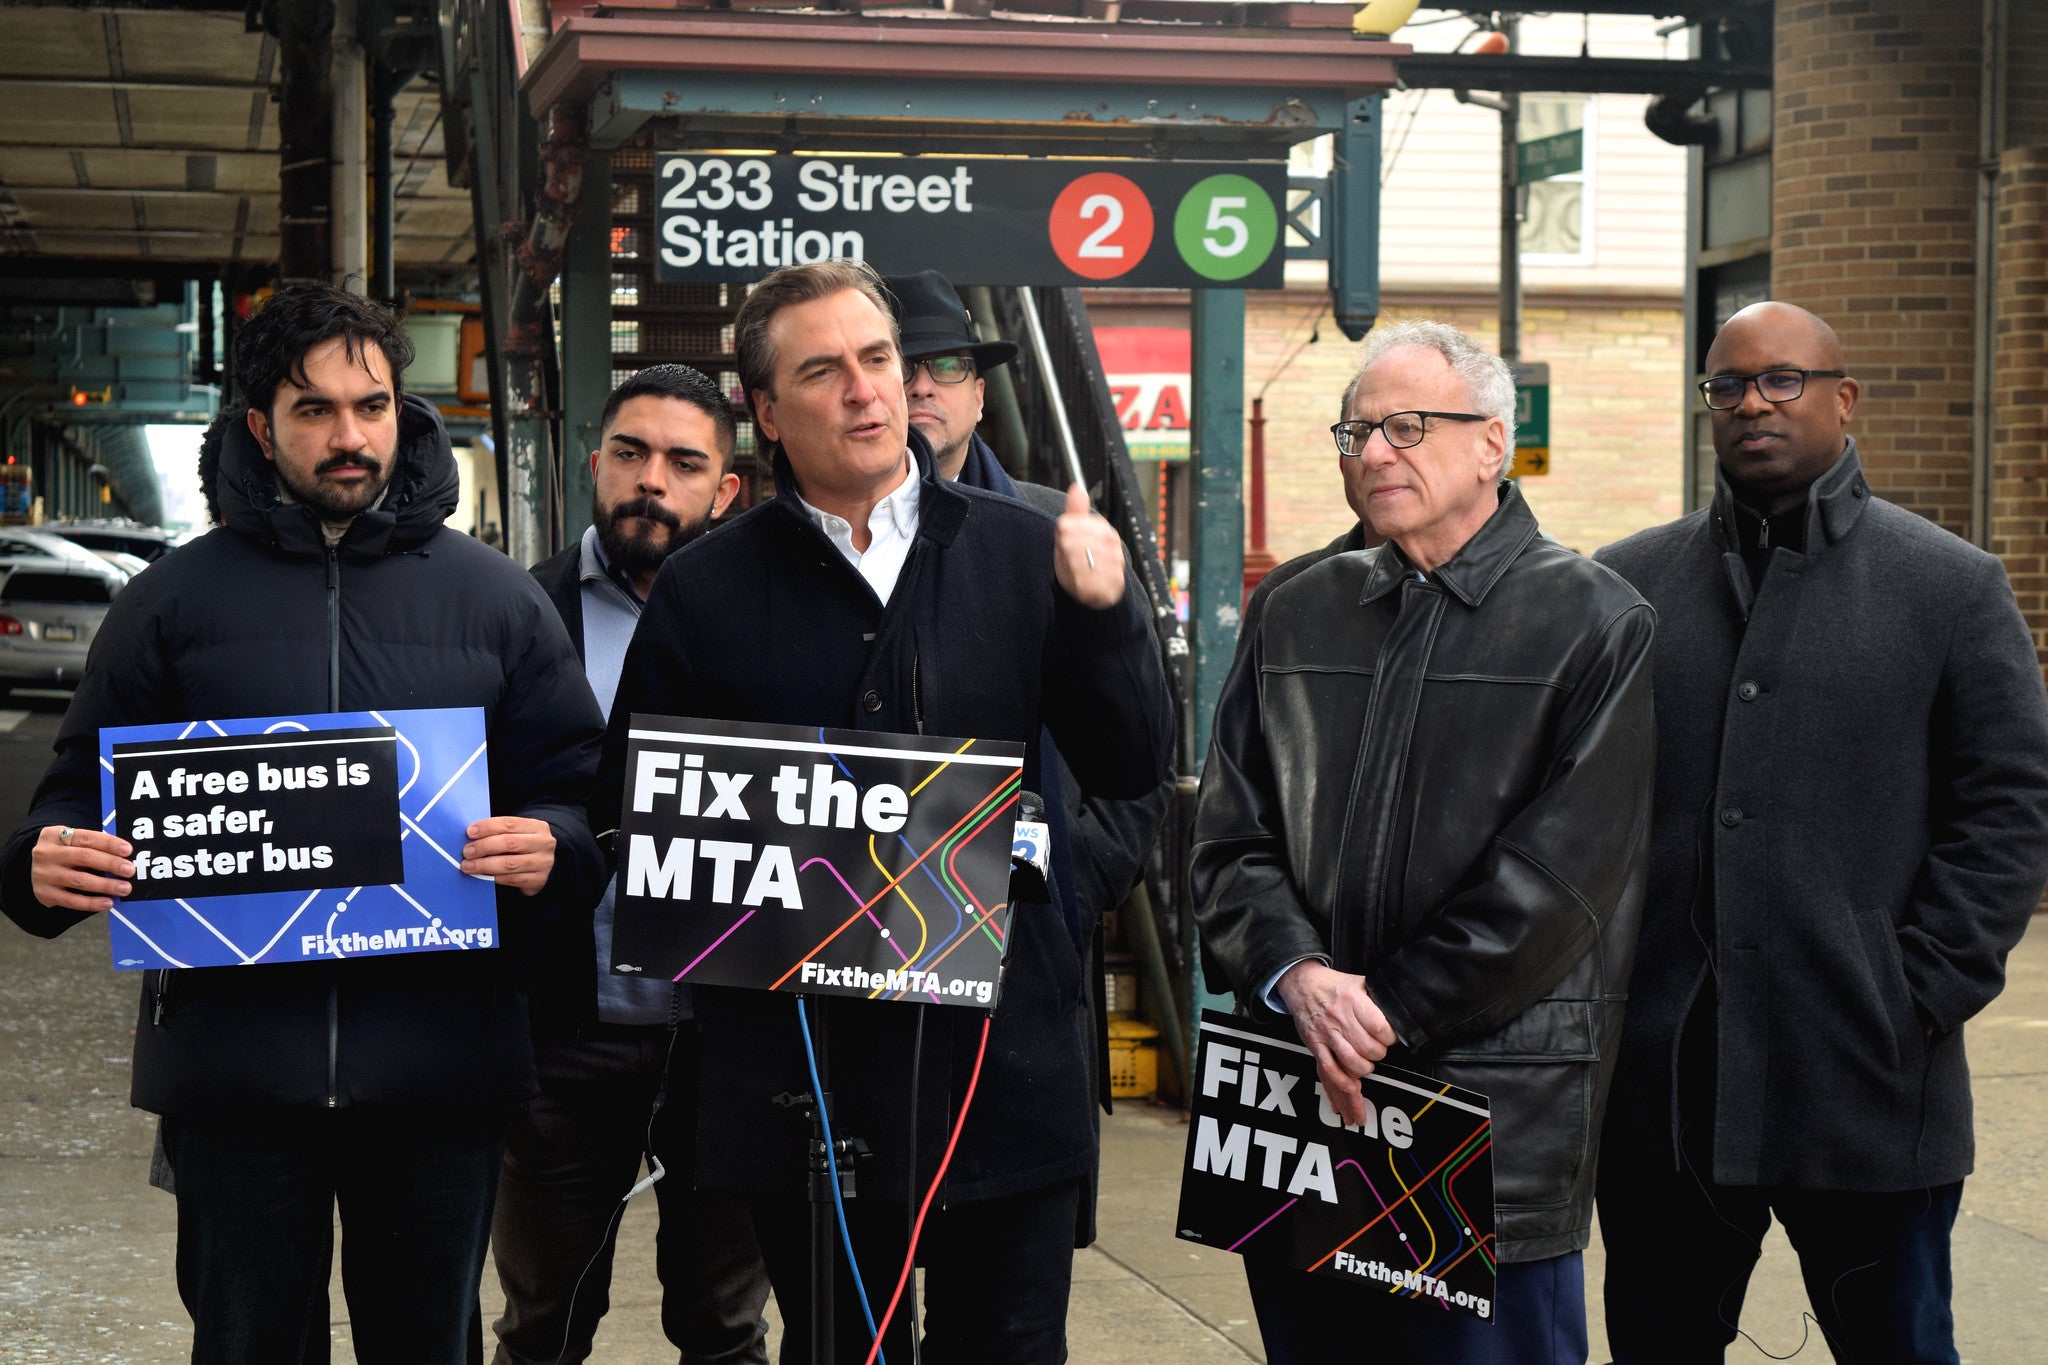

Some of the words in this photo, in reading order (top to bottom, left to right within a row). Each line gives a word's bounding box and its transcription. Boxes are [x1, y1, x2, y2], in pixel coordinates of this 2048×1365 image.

[660, 158, 774, 211] 233
[797, 160, 973, 213] Street
[660, 214, 865, 268] Station
[1078, 194, 1124, 259] 2
[1202, 195, 1249, 259] 5
[130, 770, 161, 800] A
[167, 768, 249, 797] free
[257, 761, 329, 793] bus
[336, 757, 371, 787] is
[632, 750, 754, 821] Fix
[770, 763, 909, 833] the
[131, 816, 155, 840] a
[162, 804, 274, 838] safer,
[132, 848, 254, 880] faster
[262, 842, 334, 872] bus
[626, 833, 804, 910] MTA
[301, 926, 493, 956] FixtheMTA.org
[800, 961, 994, 1004] FixtheMTA.org
[1202, 1041, 1300, 1118] Fix
[1192, 1115, 1339, 1204] MTA
[1334, 1251, 1490, 1319] FixtheMTA.org
